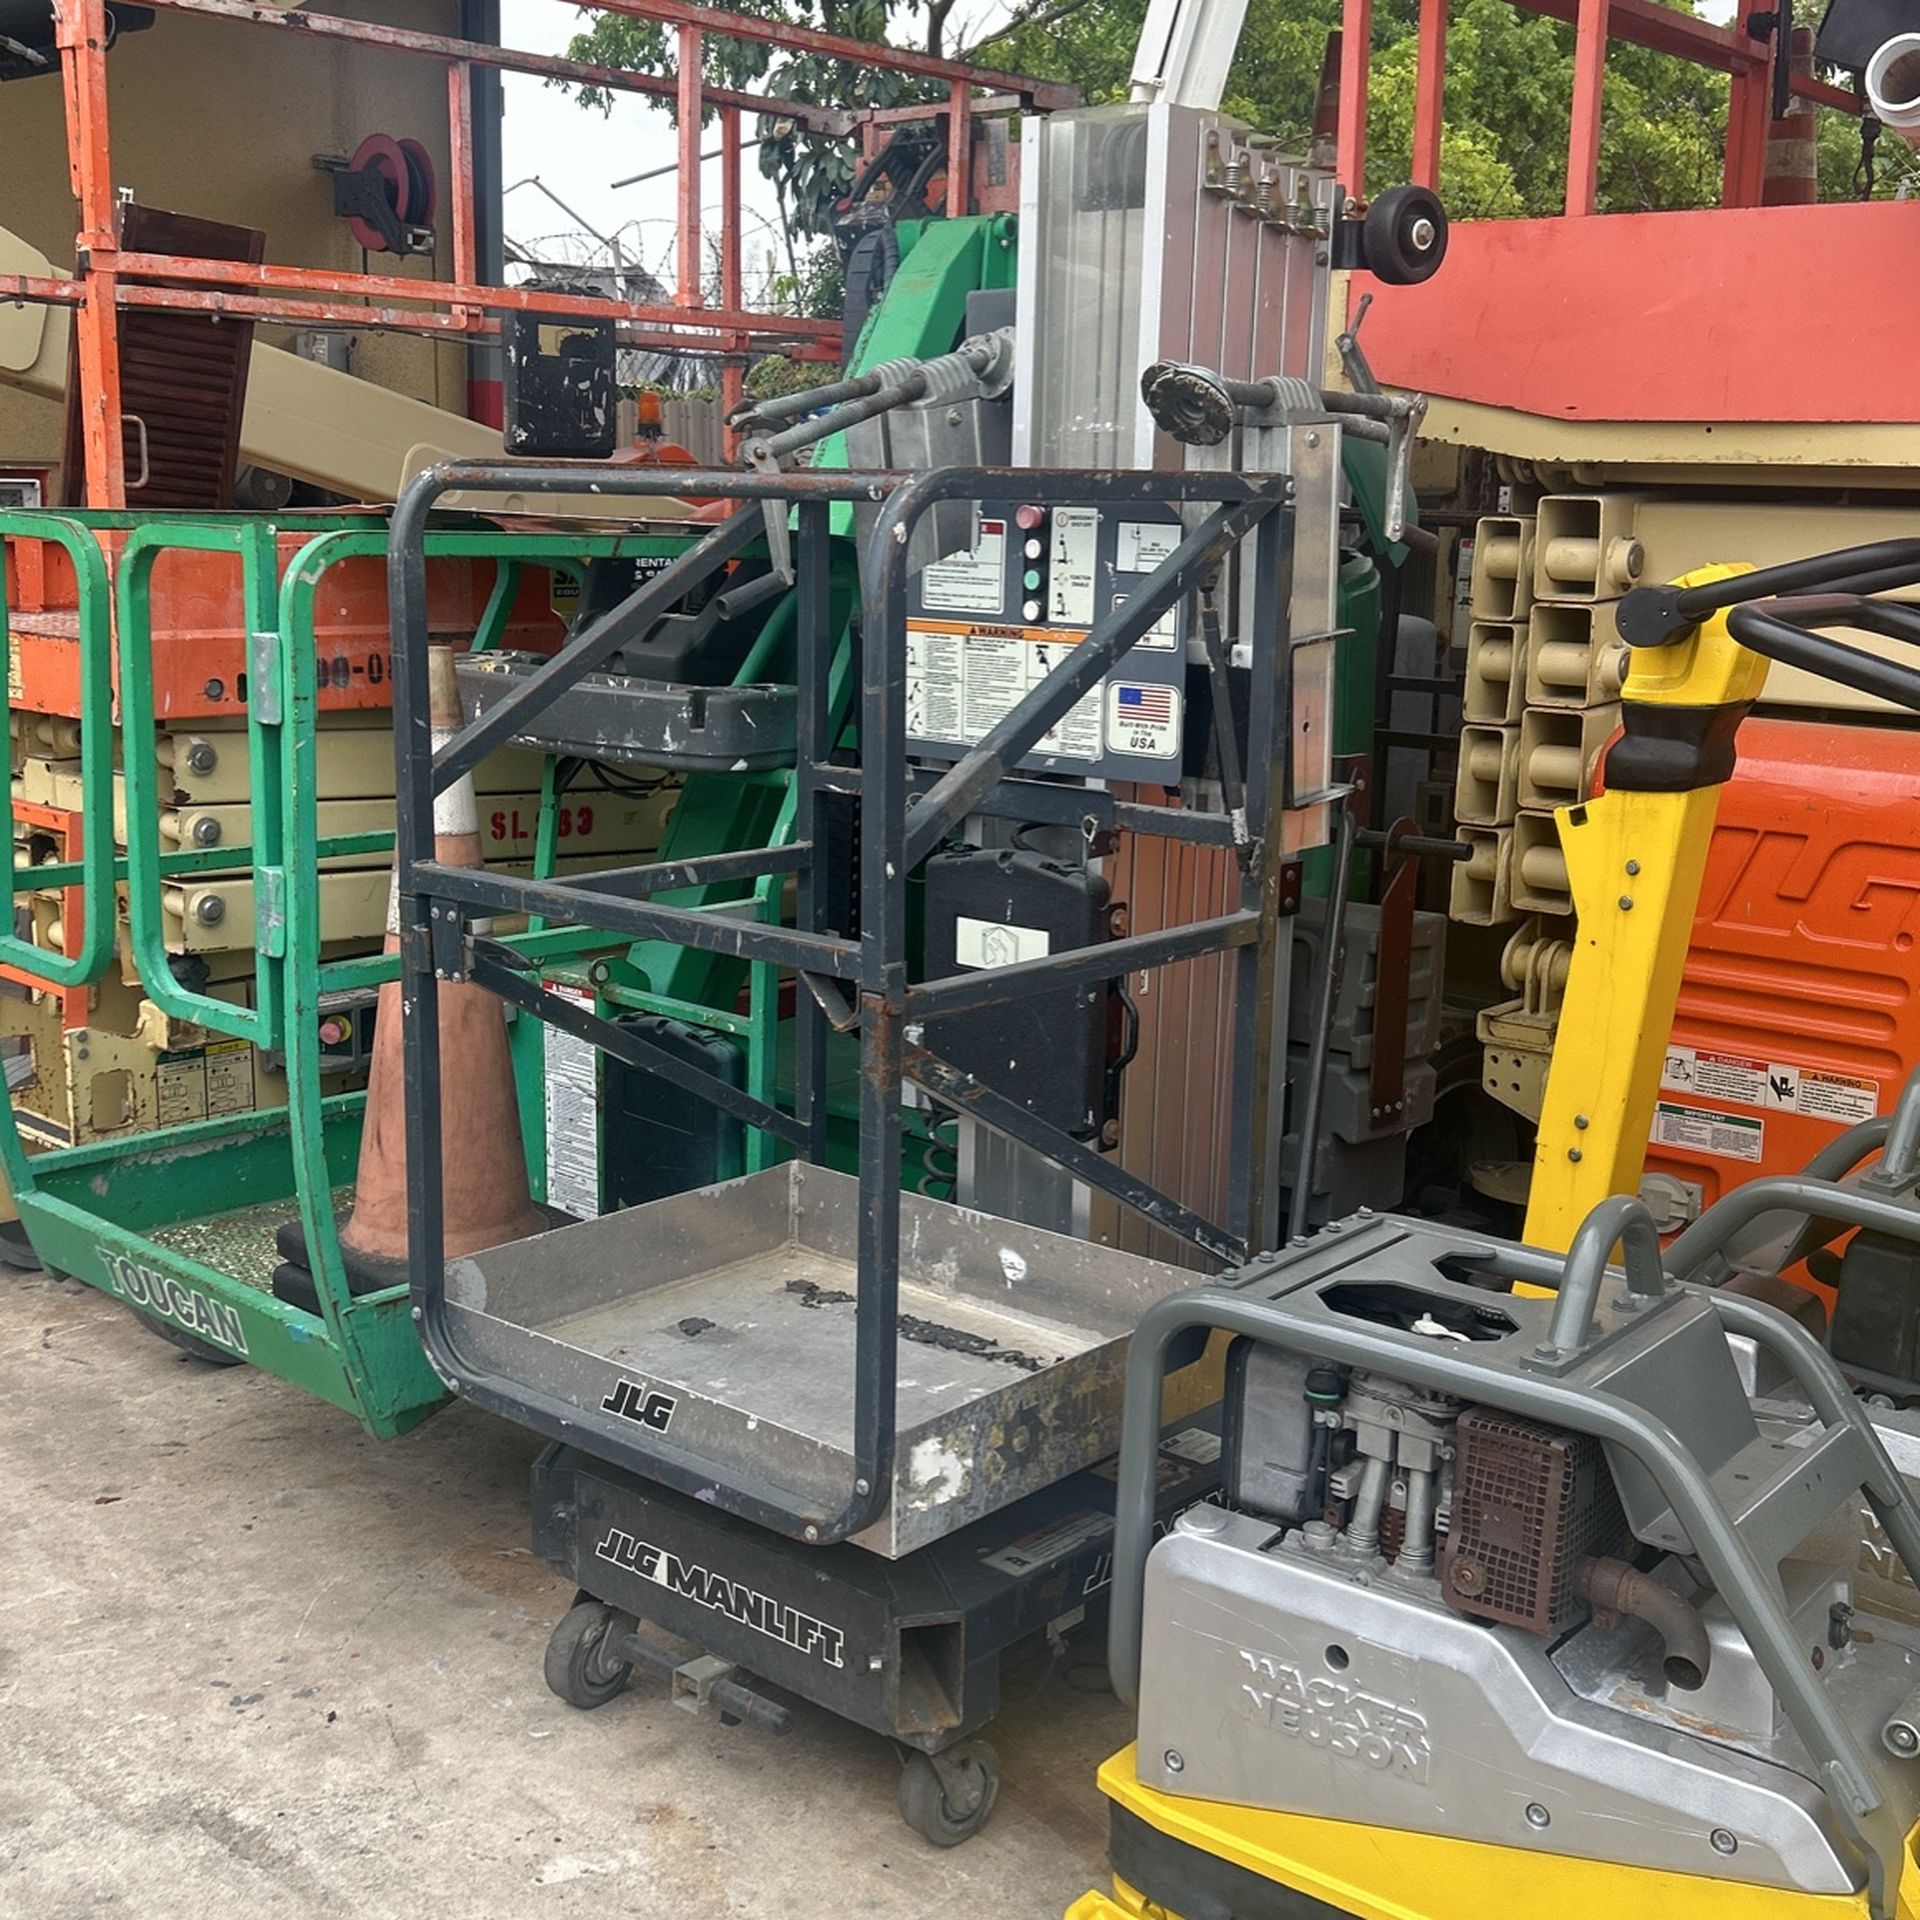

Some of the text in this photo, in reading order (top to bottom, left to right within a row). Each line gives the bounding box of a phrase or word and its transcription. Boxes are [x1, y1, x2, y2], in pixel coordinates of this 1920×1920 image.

[978, 626, 1024, 640] WARNING
[1129, 736, 1156, 750] USA
[1716, 1055, 1753, 1069] DANGER
[1821, 1073, 1862, 1089] WARNING
[1684, 1109, 1726, 1122] IMPORTANT
[94, 1245, 249, 1355] TOUCAN
[600, 1378, 678, 1434] JLG
[595, 1528, 662, 1582] JLG
[1239, 1650, 1431, 1752] WACKER
[1241, 1683, 1431, 1786] NEUSON
